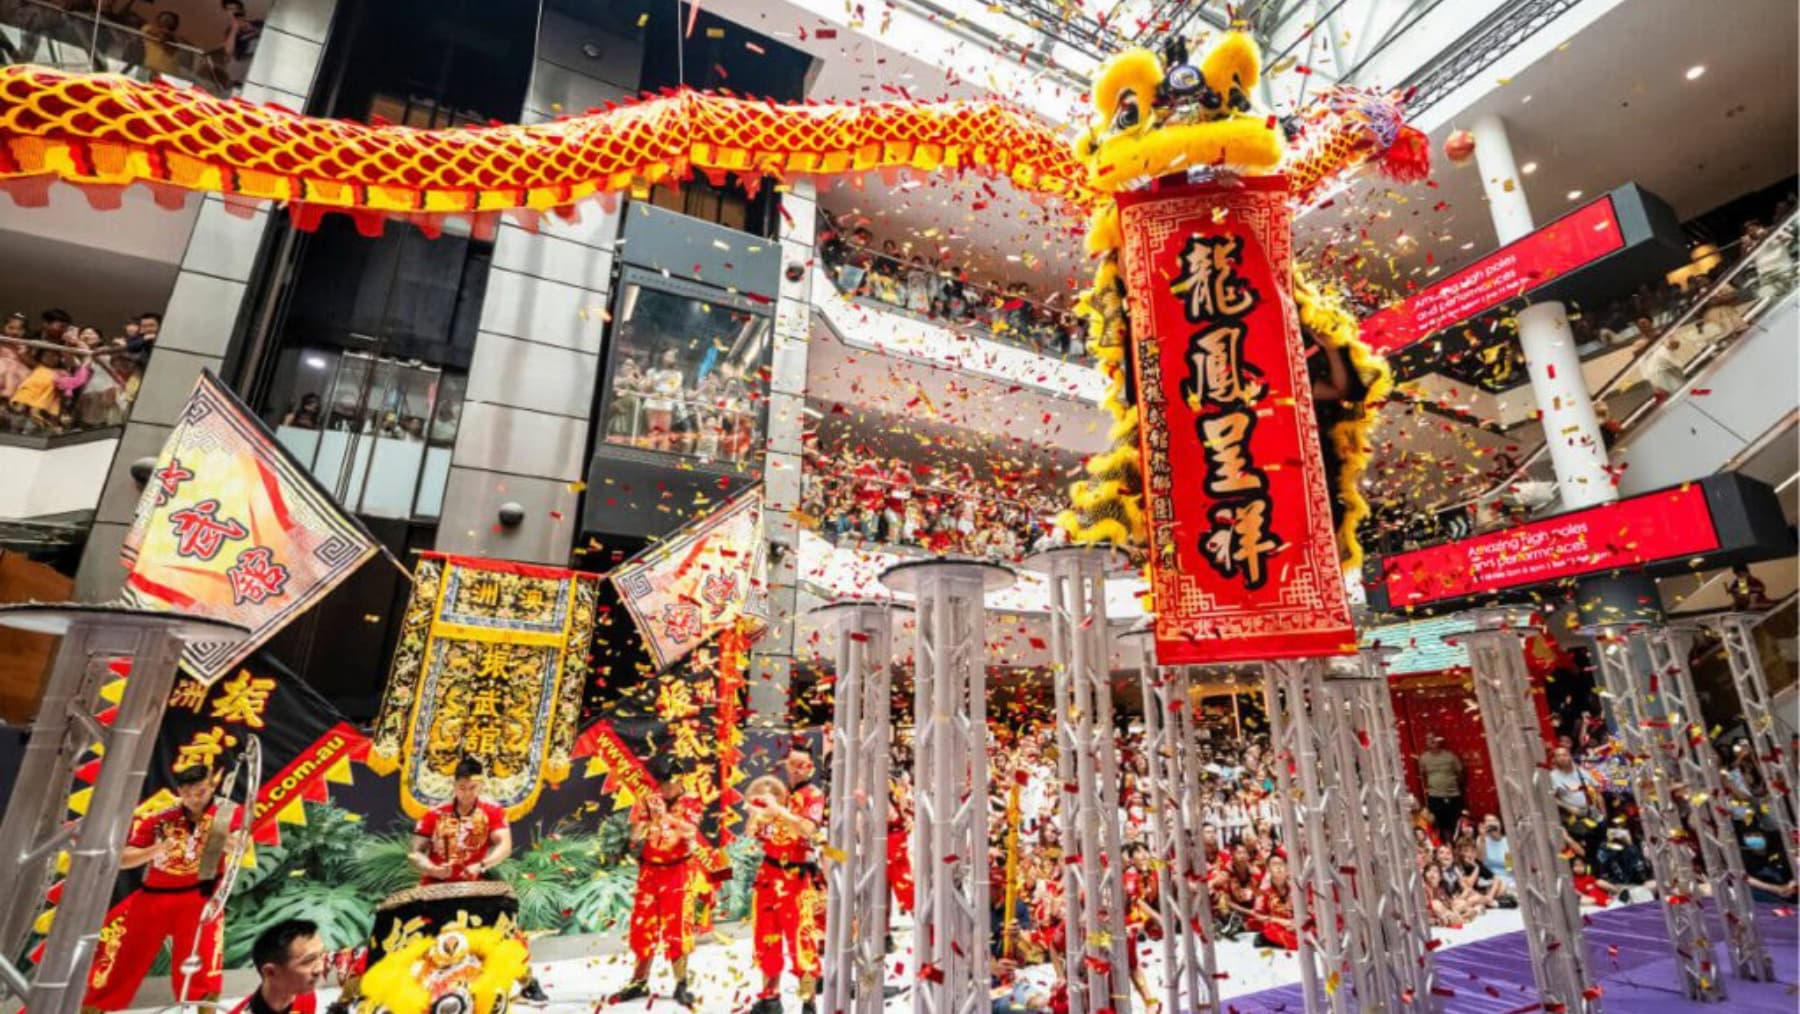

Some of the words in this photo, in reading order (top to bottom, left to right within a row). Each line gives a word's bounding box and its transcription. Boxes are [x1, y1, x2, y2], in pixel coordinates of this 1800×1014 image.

[1415, 284, 1459, 309] Amang
[1485, 255, 1516, 276] poles
[1417, 304, 1437, 321] and
[1181, 237, 1279, 588] 龍鳳呈祥
[1468, 535, 1519, 557] Aazing
[1498, 541, 1588, 569] perormaces
